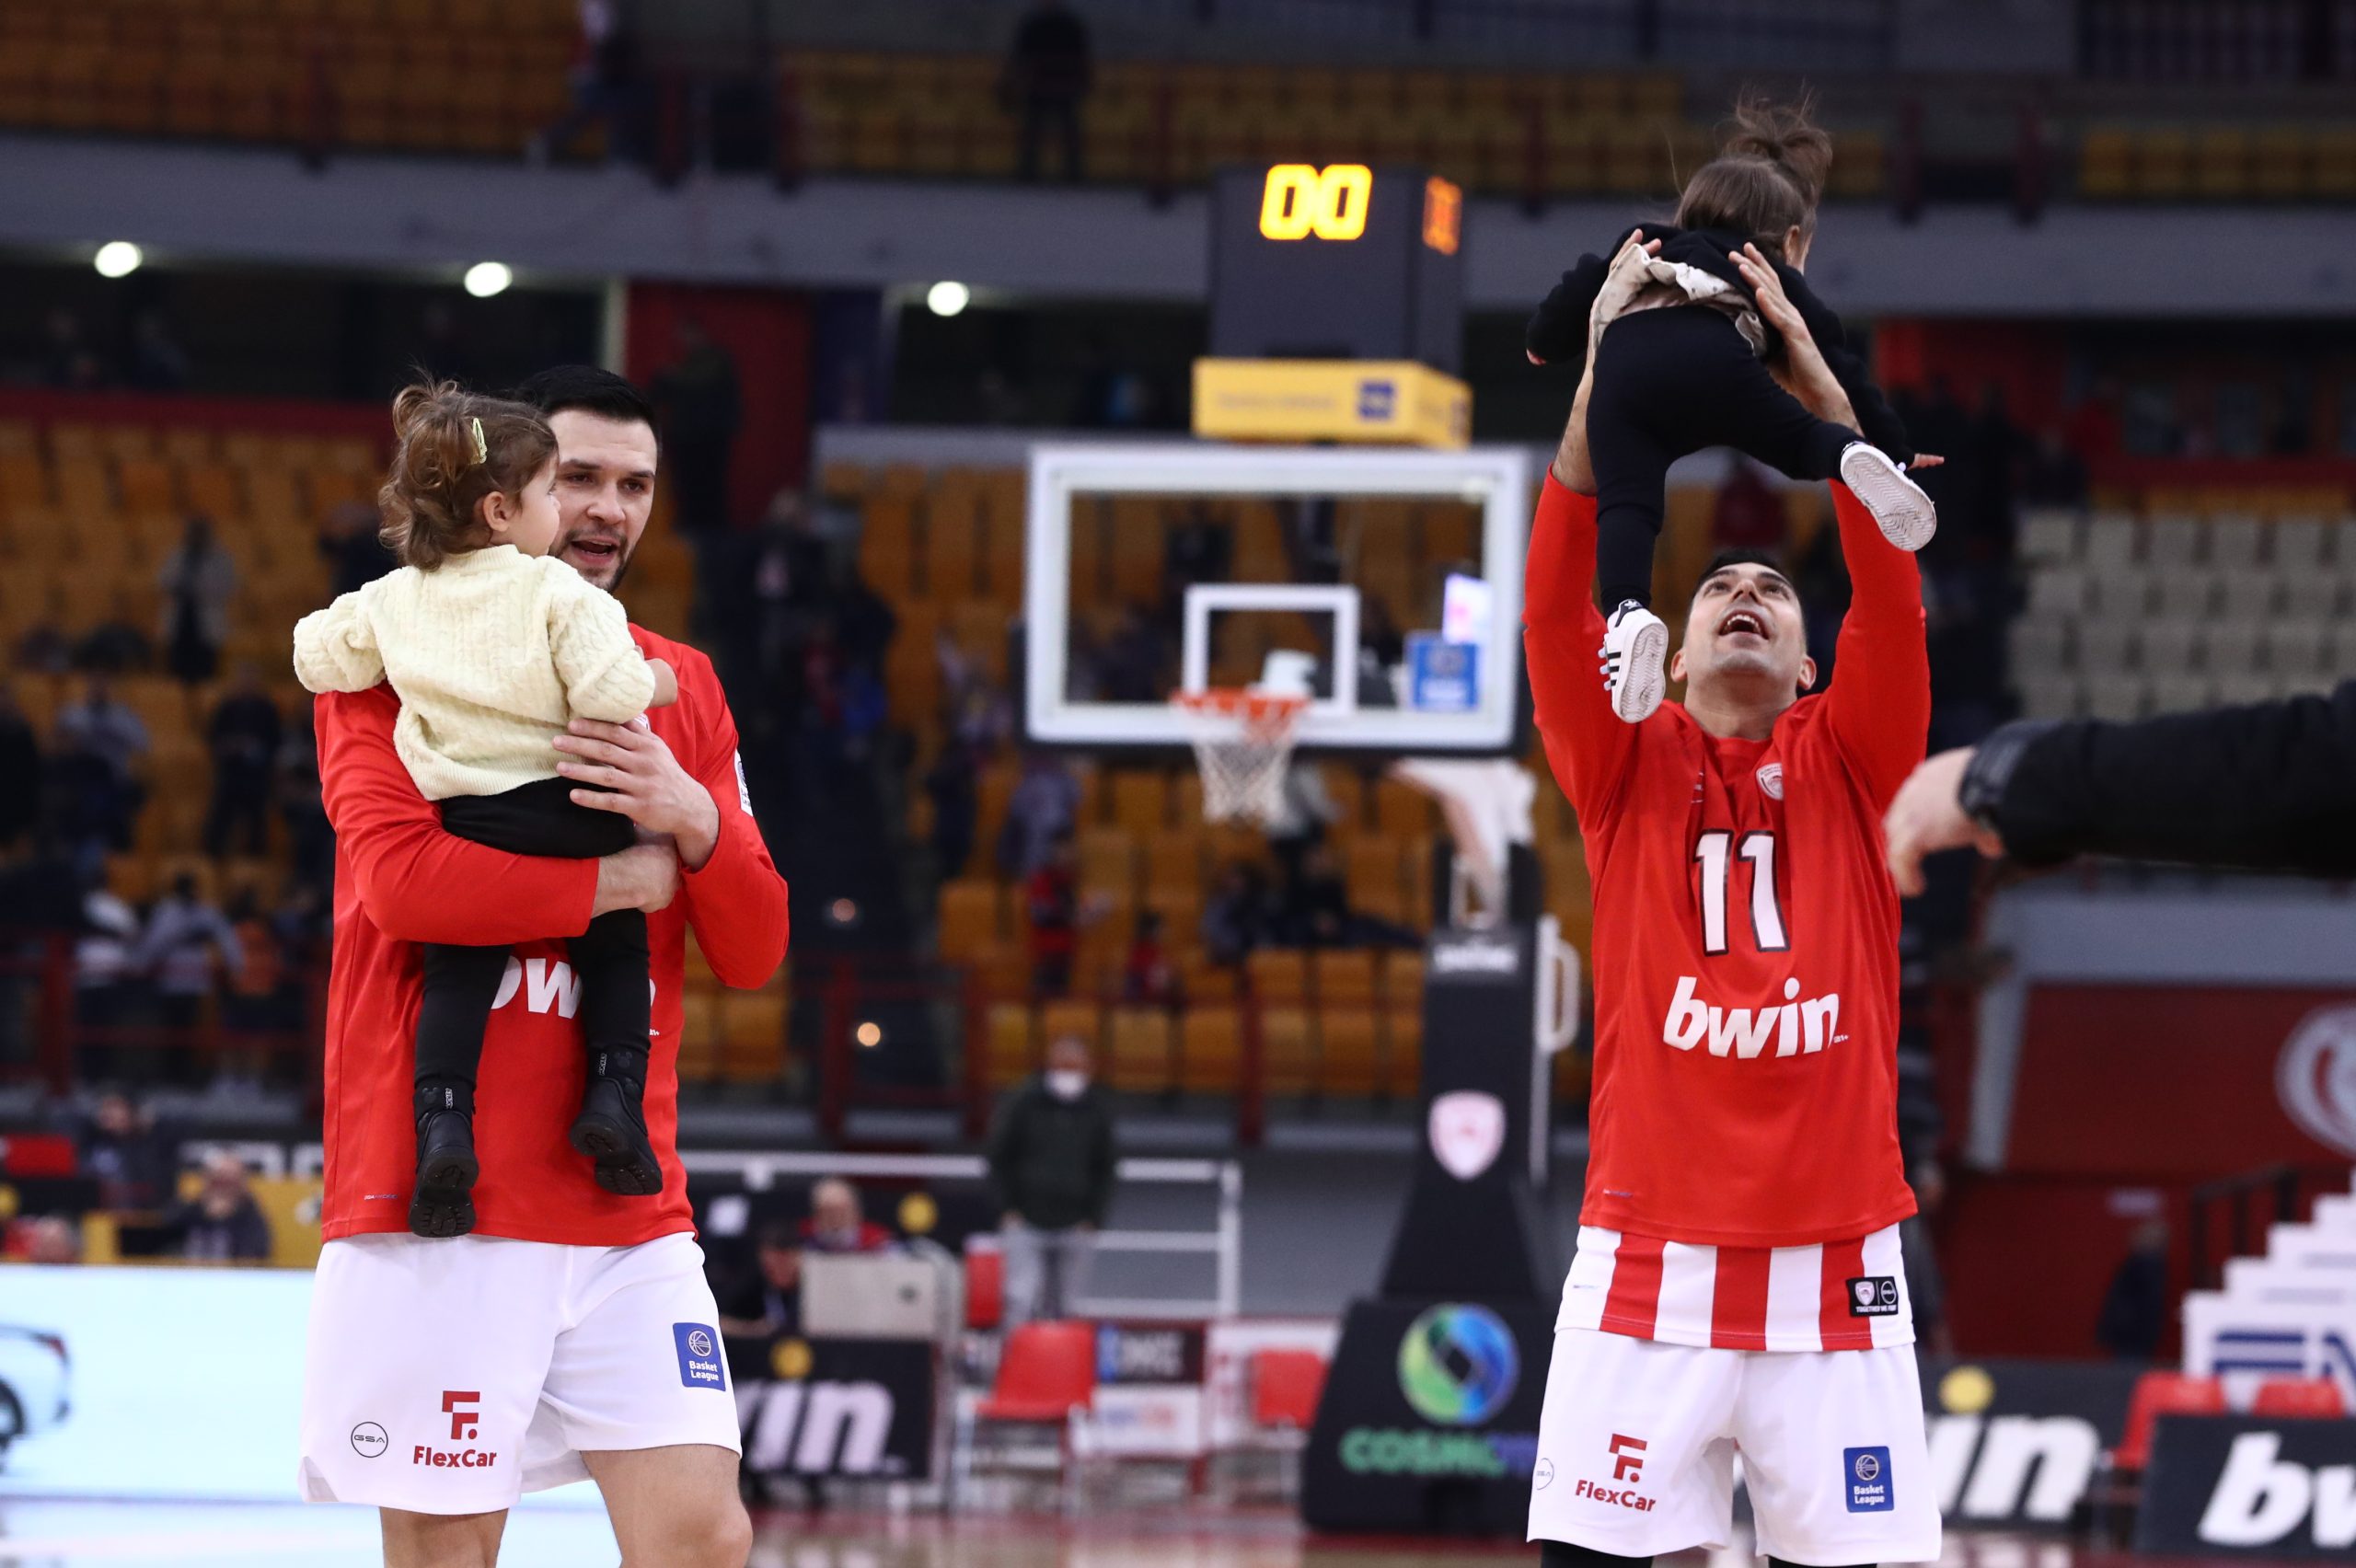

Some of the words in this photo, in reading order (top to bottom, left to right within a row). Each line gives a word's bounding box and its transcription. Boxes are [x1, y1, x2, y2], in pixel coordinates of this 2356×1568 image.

[1259, 164, 1373, 240] 00
[1692, 828, 1791, 957] 11
[1663, 975, 1840, 1059] bwin
[688, 1360, 718, 1373] Basket
[690, 1369, 720, 1382] League
[735, 1337, 895, 1472] in
[353, 1434, 386, 1444] GSA
[413, 1445, 497, 1468] FlexCar
[1575, 1479, 1656, 1512] FlexCar
[1854, 1484, 1885, 1495] Basket
[1854, 1495, 1885, 1506] League
[2197, 1431, 2356, 1549] b
